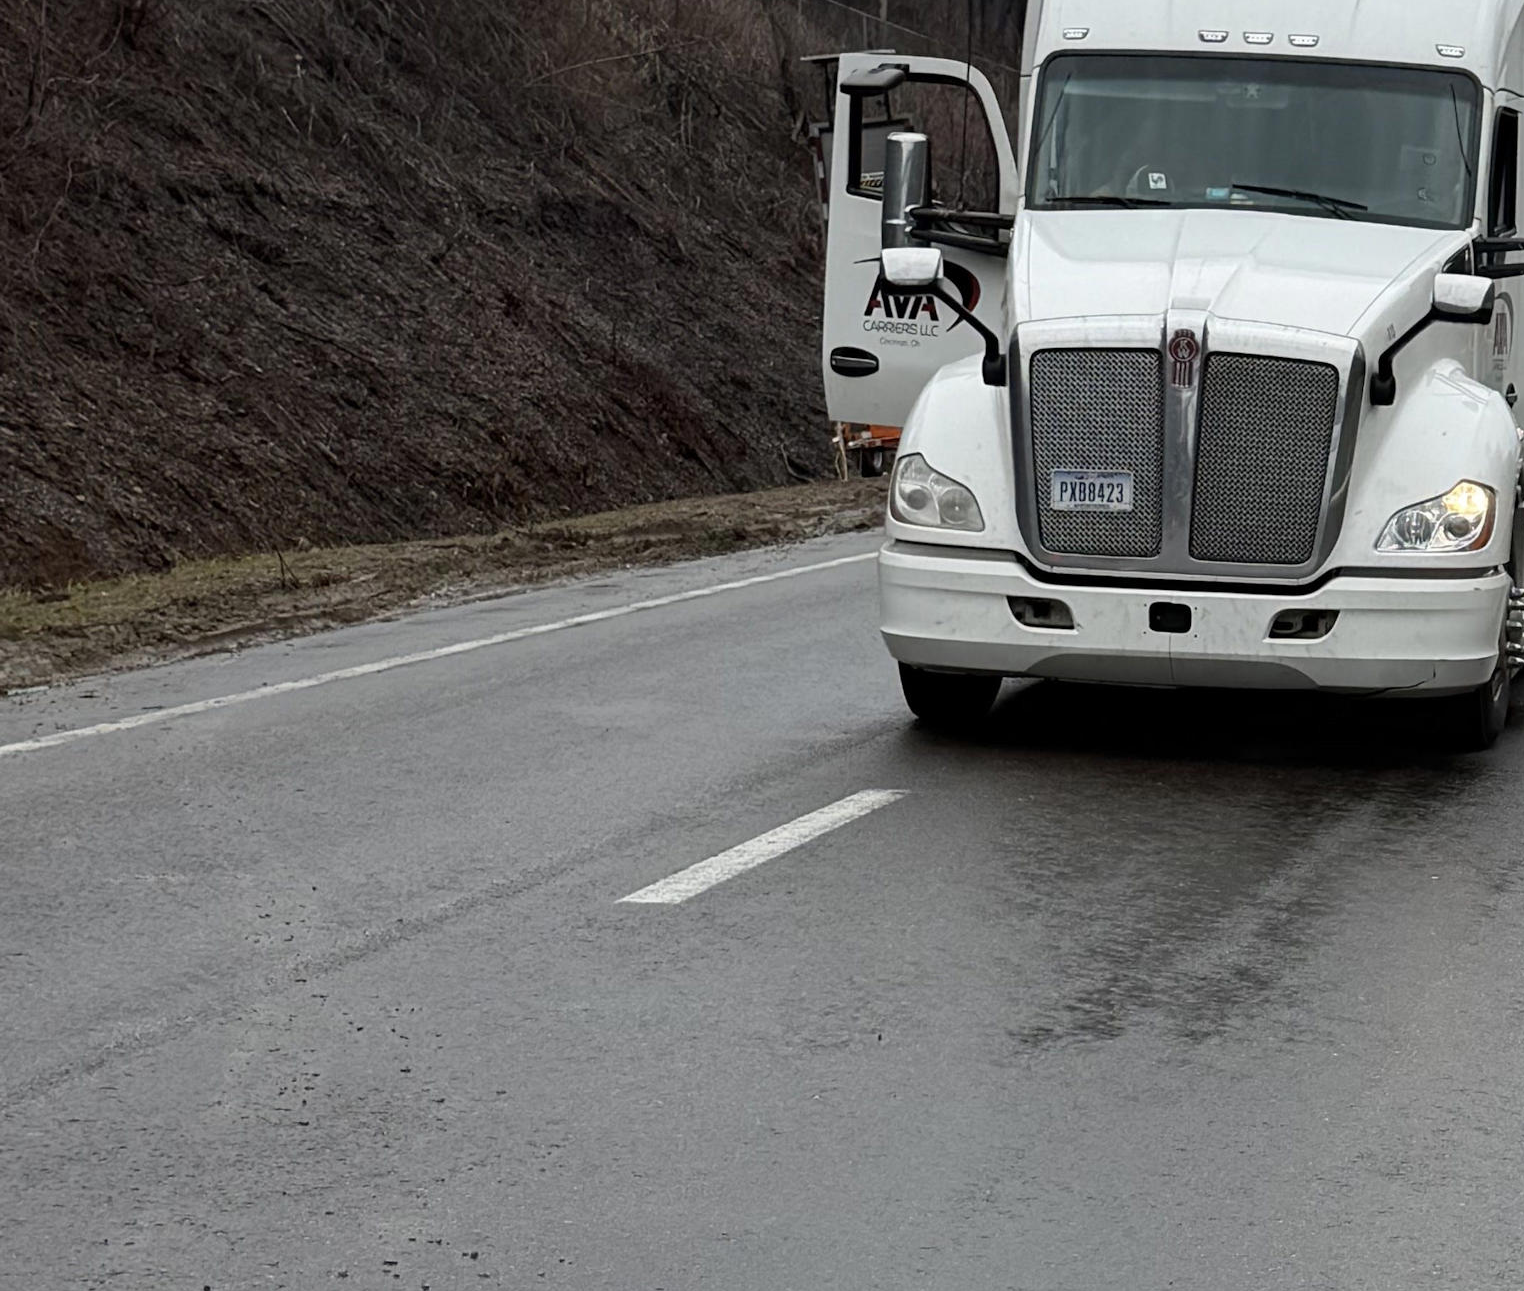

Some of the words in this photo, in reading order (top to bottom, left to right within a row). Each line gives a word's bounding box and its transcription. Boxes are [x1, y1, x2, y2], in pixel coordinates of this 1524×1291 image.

[864, 276, 939, 321] AVA
[863, 320, 918, 335] CARRIERS
[920, 324, 939, 337] LLC
[1060, 481, 1124, 503] PXB8423
